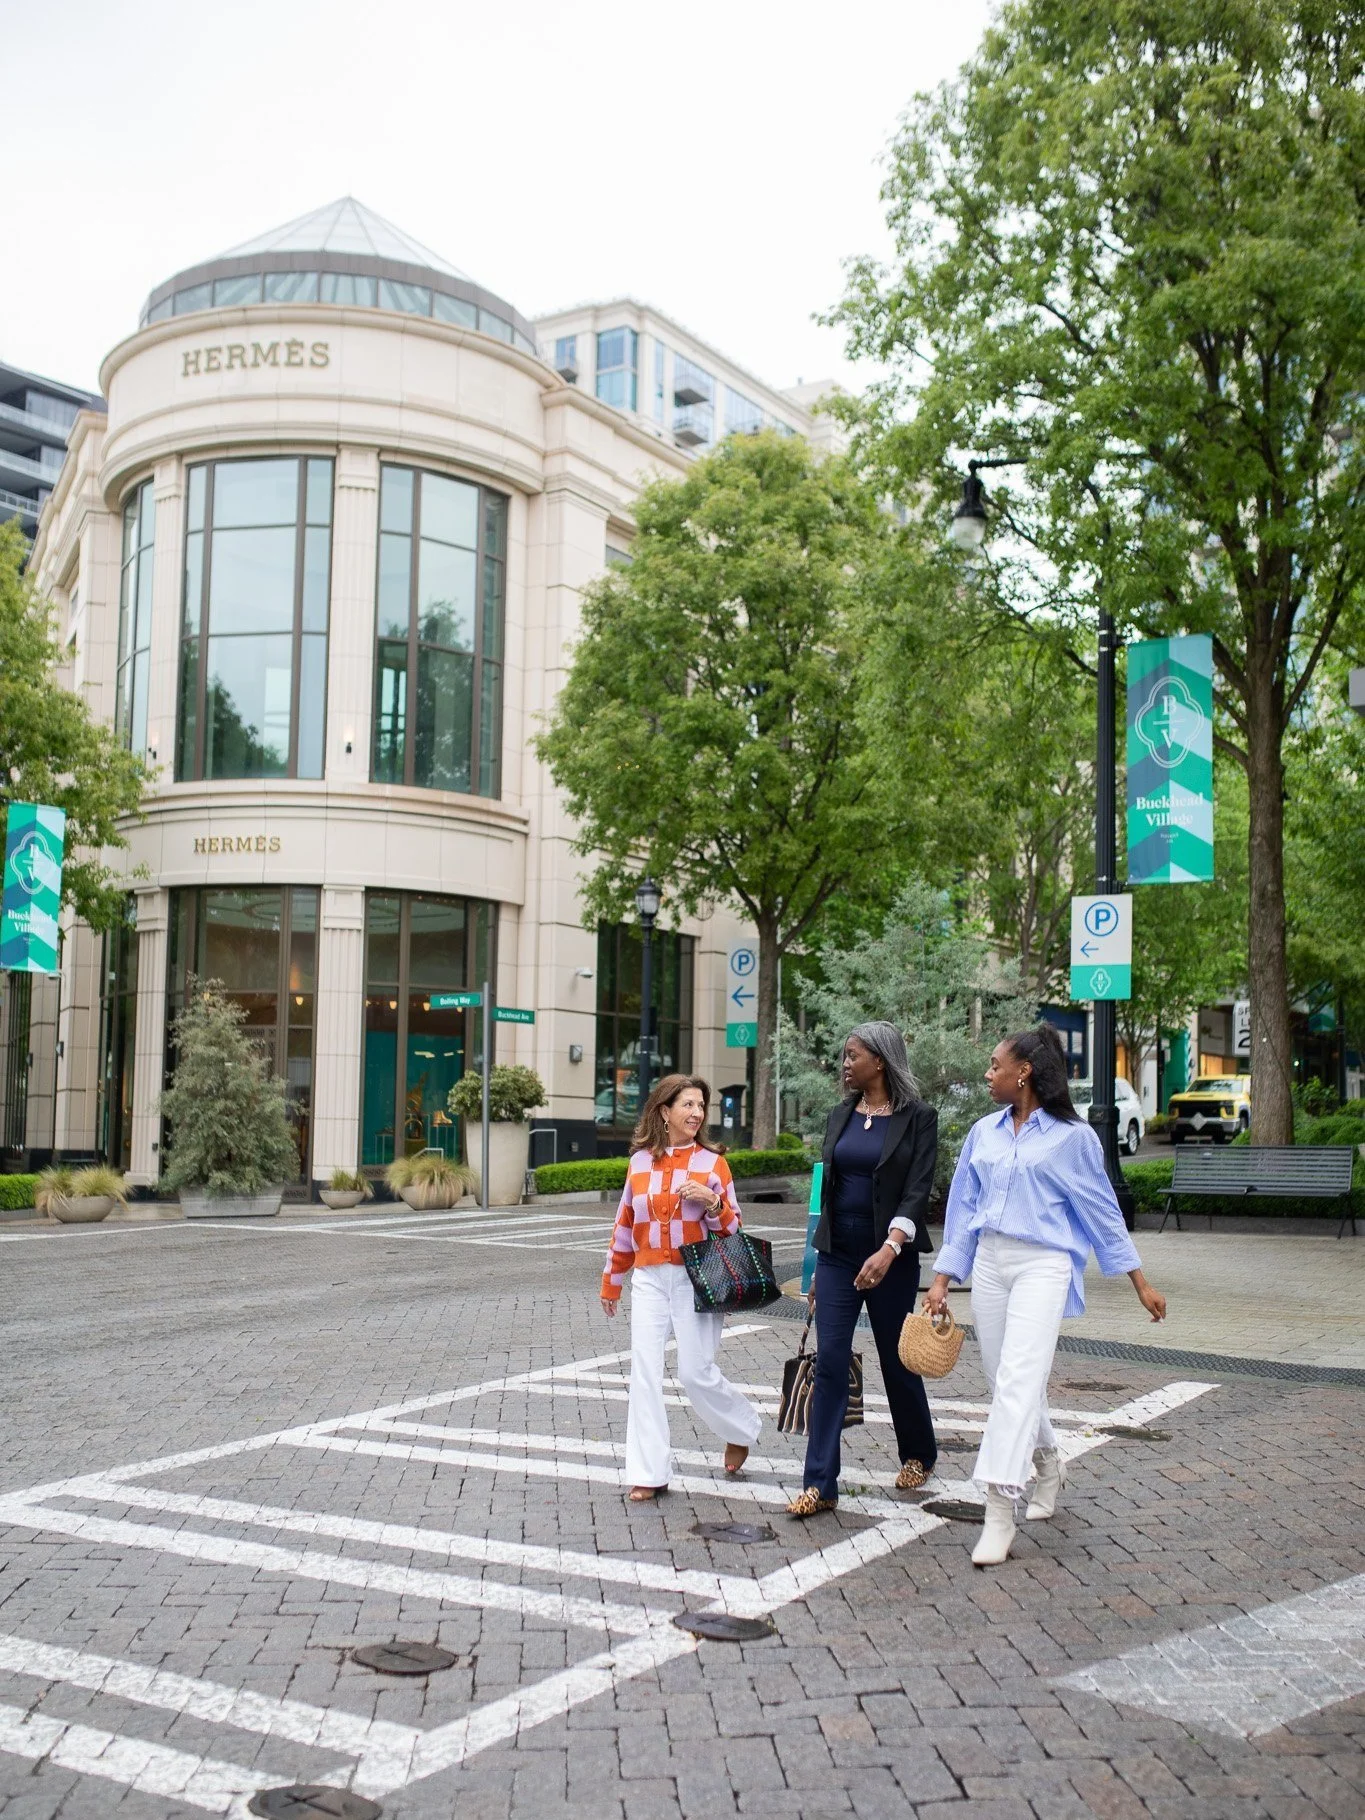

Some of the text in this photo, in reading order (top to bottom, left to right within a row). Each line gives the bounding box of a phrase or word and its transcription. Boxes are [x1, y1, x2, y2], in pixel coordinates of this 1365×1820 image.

[182, 338, 330, 377] HERMÈS
[1136, 792, 1203, 810] Buckhead
[1146, 812, 1194, 828] Village
[193, 834, 281, 854] HERMÈS
[1095, 909, 1111, 930] P
[738, 954, 750, 971] P
